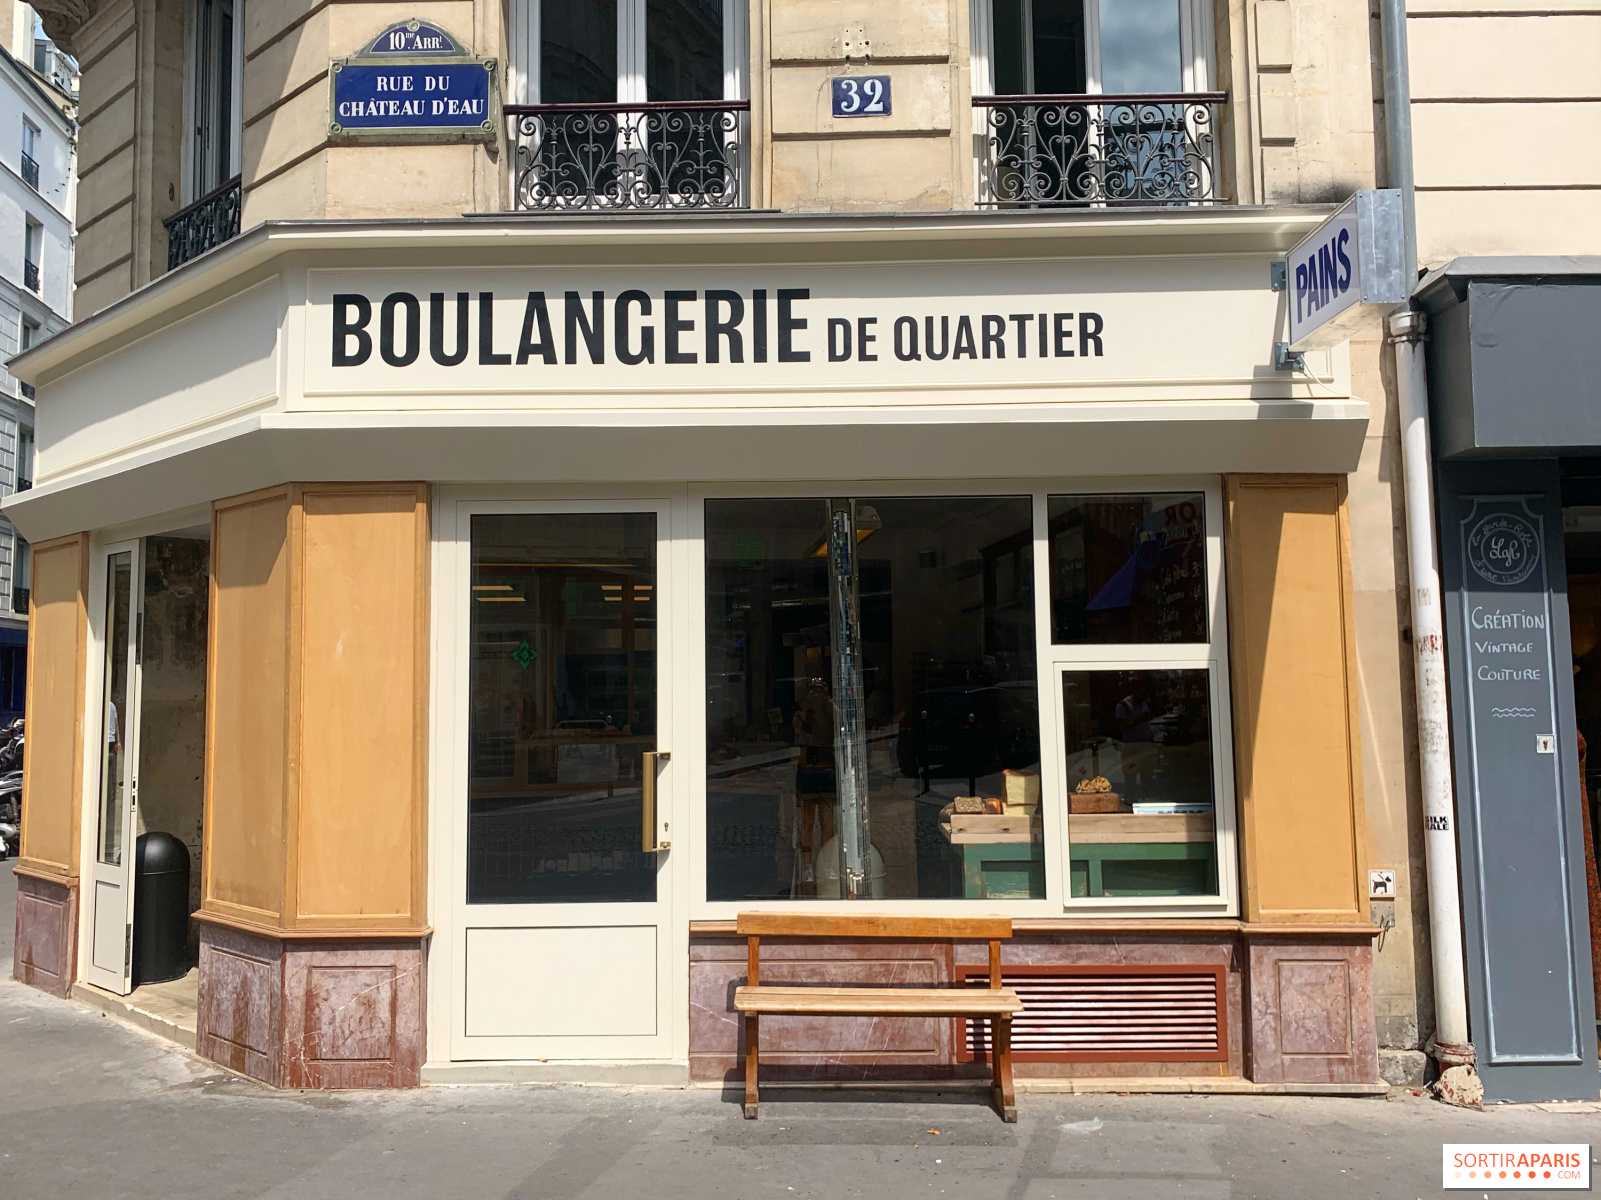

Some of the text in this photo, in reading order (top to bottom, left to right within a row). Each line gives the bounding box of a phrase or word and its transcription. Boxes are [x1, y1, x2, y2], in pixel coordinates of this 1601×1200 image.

[376, 76, 450, 91] RUE DU
[840, 79, 884, 112] 32
[338, 97, 485, 117] CHÂTEAU D'EAU
[1295, 228, 1351, 324] PAINS
[332, 288, 1104, 367] BOULANGERIE DE QUARTIER
[1477, 665, 1541, 681] COUTURE
